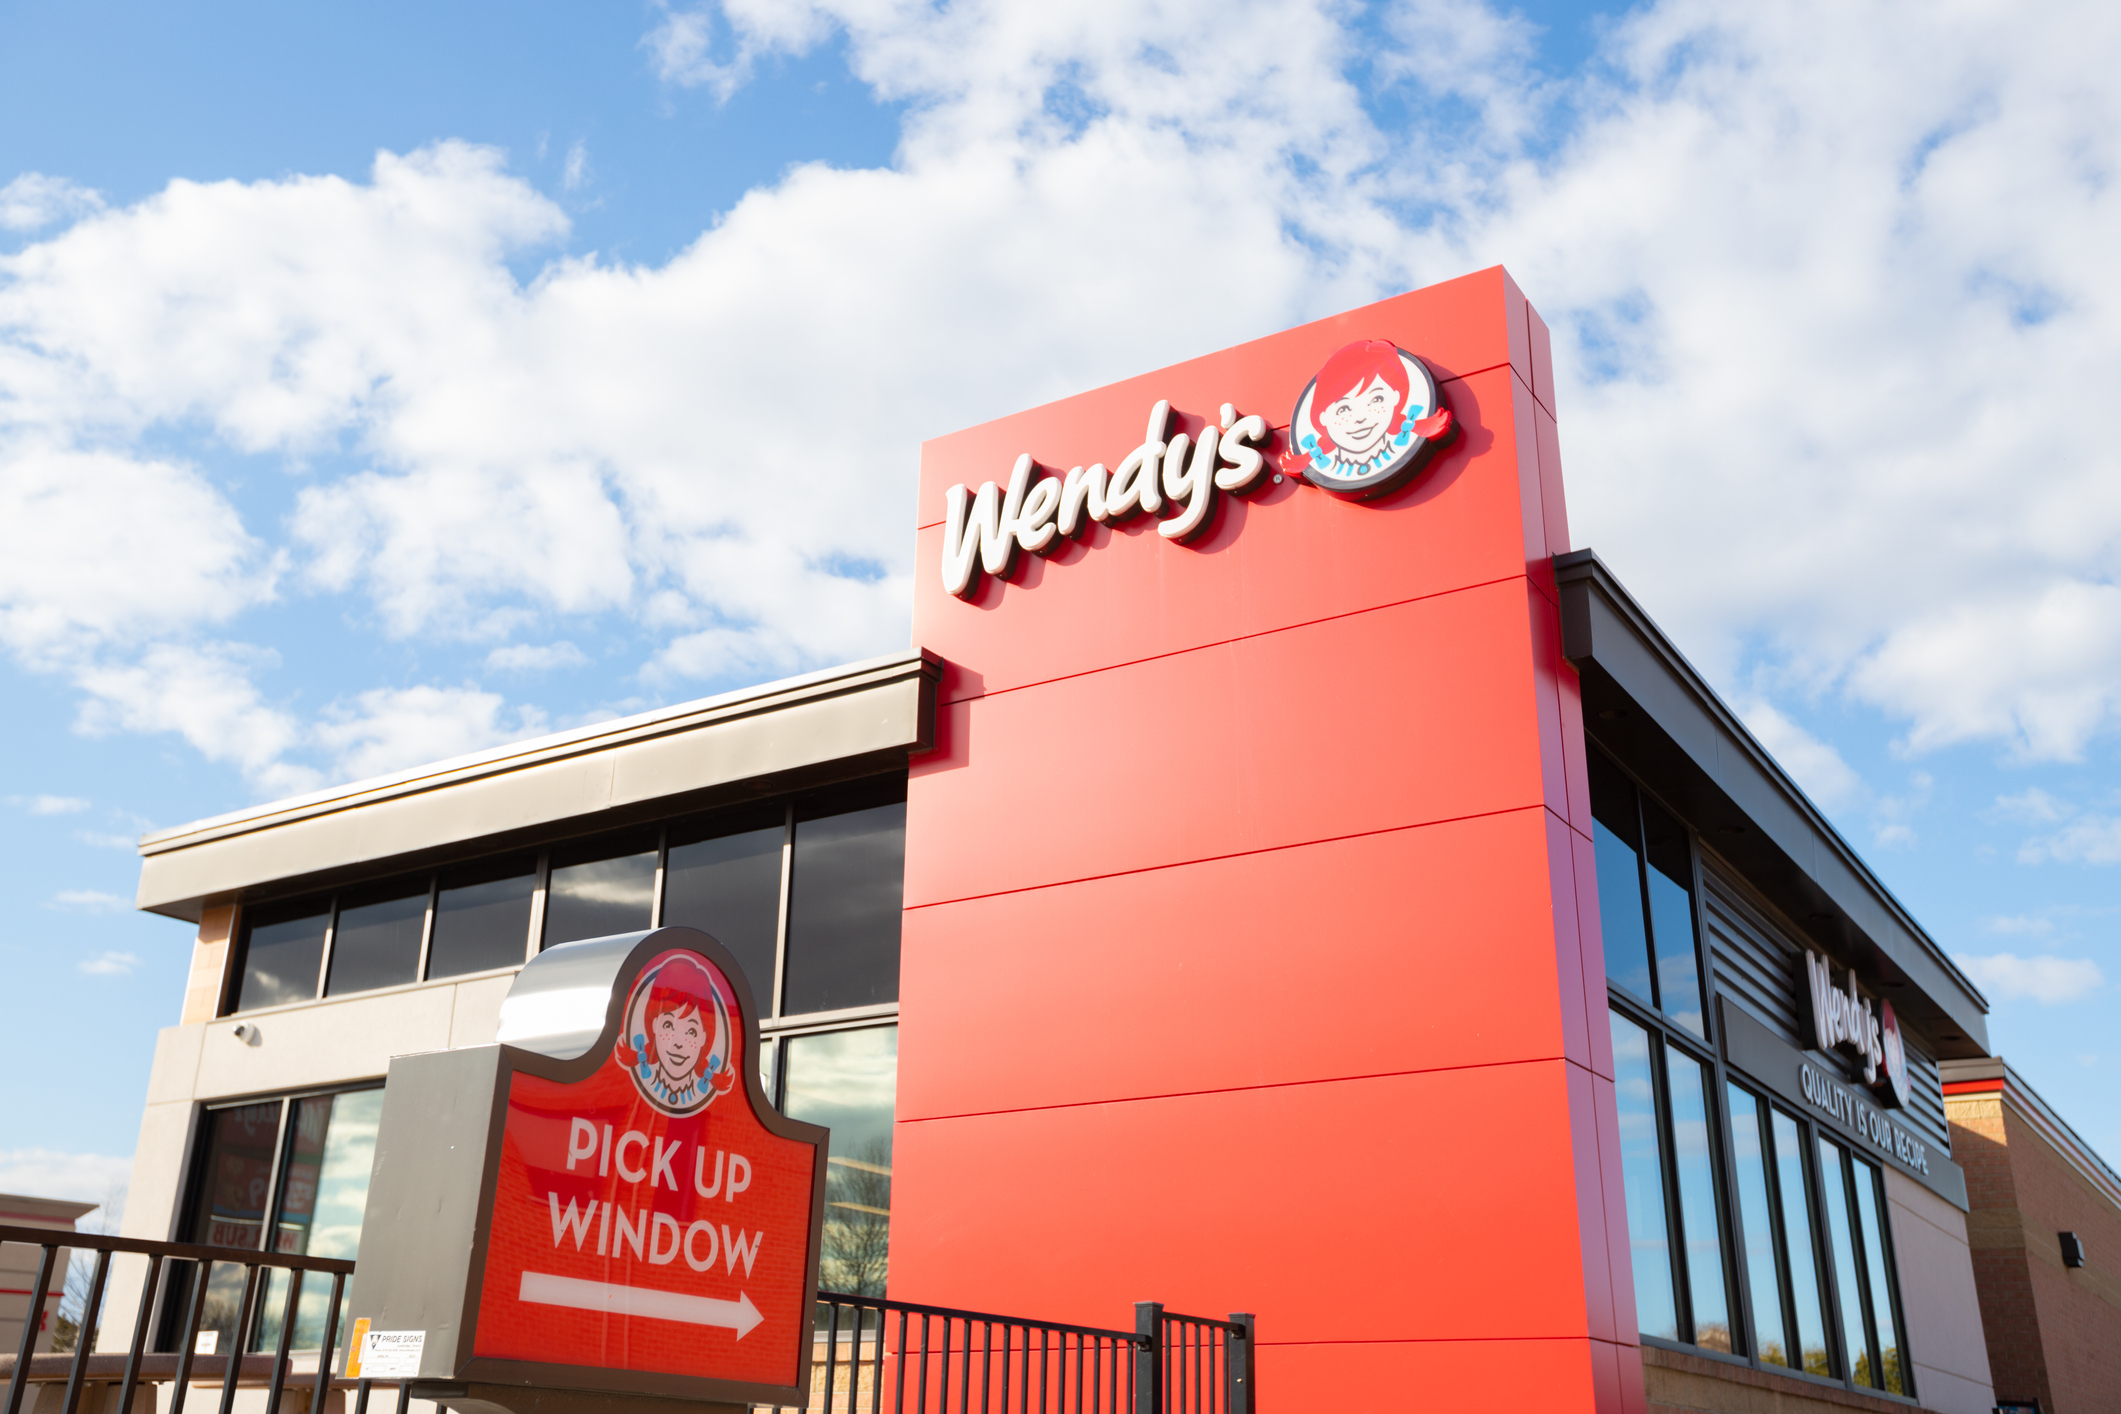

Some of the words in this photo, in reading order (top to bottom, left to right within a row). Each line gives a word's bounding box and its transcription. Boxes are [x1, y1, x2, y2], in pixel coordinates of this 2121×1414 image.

[941, 399, 1267, 597] Wendy's
[1805, 949, 1883, 1085] Wendy's
[566, 1117, 682, 1192] PICK
[694, 1145, 752, 1202] UP
[1802, 1063, 1853, 1126] QUALITY
[1855, 1100, 1868, 1137] IS
[1869, 1110, 1894, 1153] OUR
[1894, 1127, 1929, 1176] RECIPE
[548, 1191, 764, 1280] WINDOW
[382, 1335, 401, 1343] PRIDE
[403, 1335, 423, 1343] SIGNS
